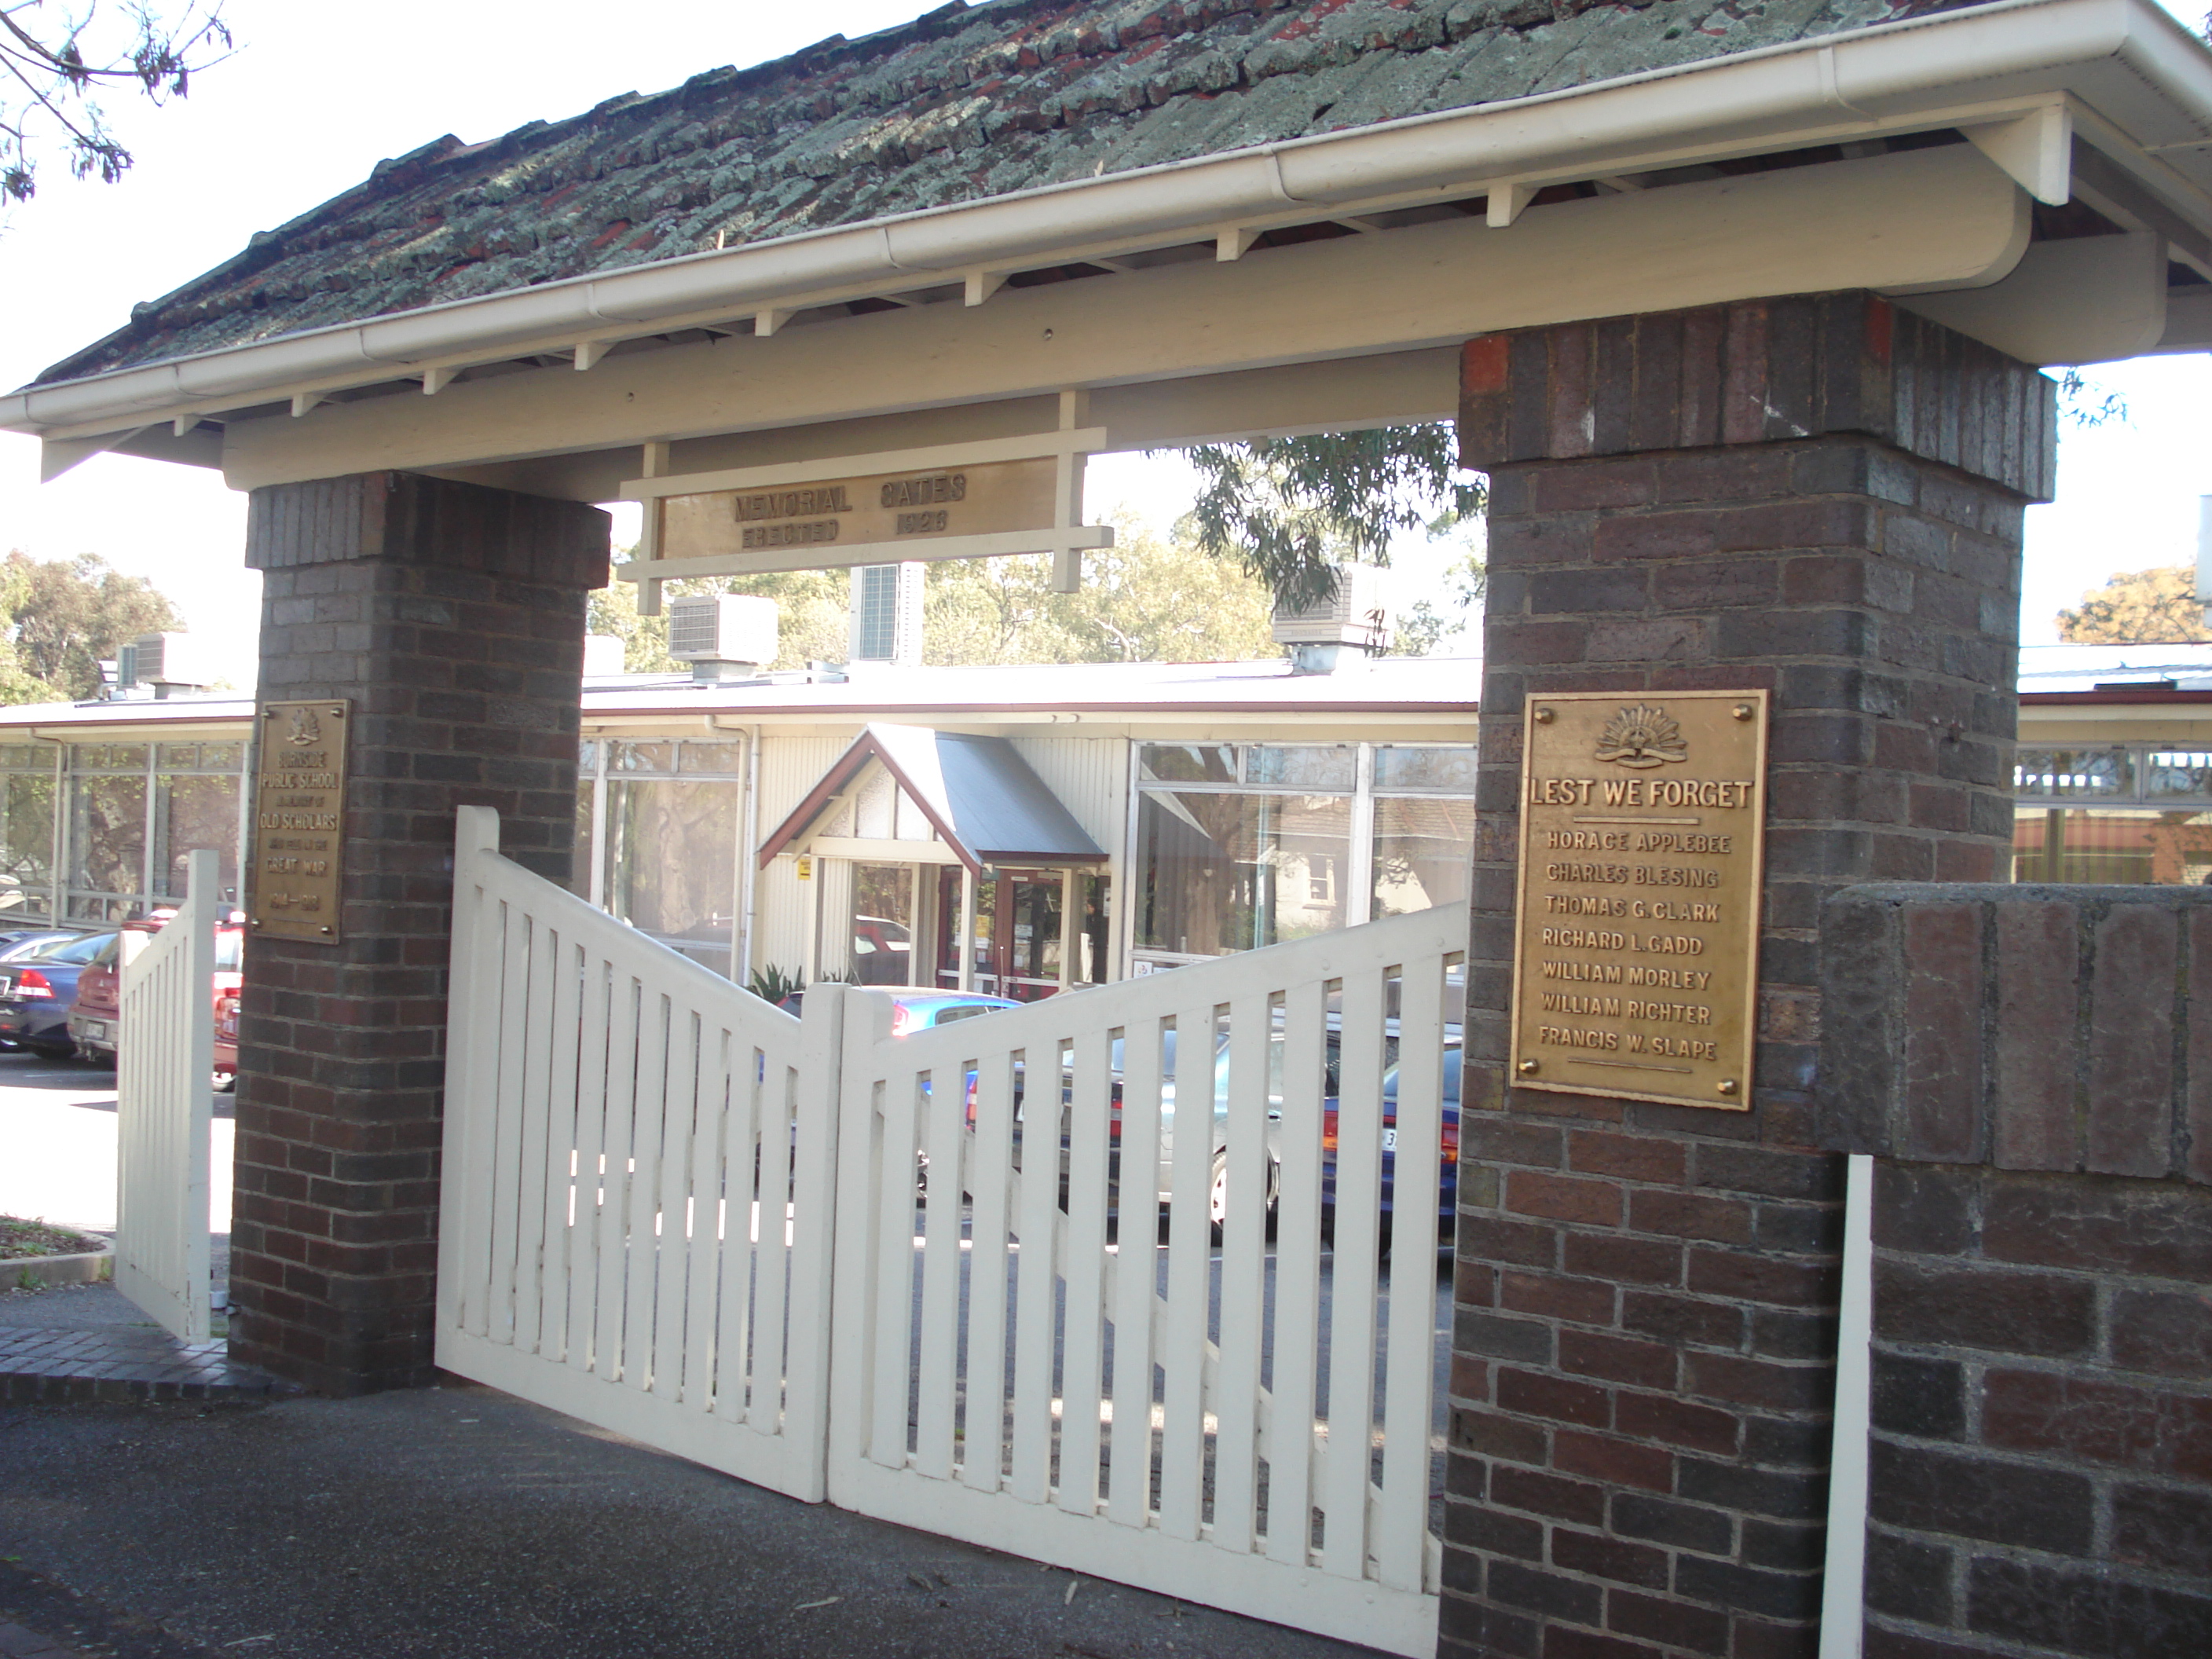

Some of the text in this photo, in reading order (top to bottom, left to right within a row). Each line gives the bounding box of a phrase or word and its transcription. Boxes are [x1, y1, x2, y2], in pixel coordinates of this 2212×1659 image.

[734, 474, 967, 522] MEMORIAL GATES
[742, 518, 840, 550] ERECTED
[262, 772, 339, 789] PUBLIC SCHOOL
[1531, 778, 1754, 809] LEST WE FORGET
[258, 813, 337, 831] OLD SCHOLARS
[1547, 831, 1732, 855] HORACE APPLEBEE
[1546, 863, 1719, 889] CHARLES BLESING
[1544, 894, 1627, 918] THOMAS
[1542, 927, 1625, 950] RICHARD
[1543, 961, 1712, 991] WILLIAM MORLEY
[1540, 992, 1711, 1025] WILLIAM RICHTER
[1539, 1026, 1717, 1061] FRANCIS W. SLAPE
